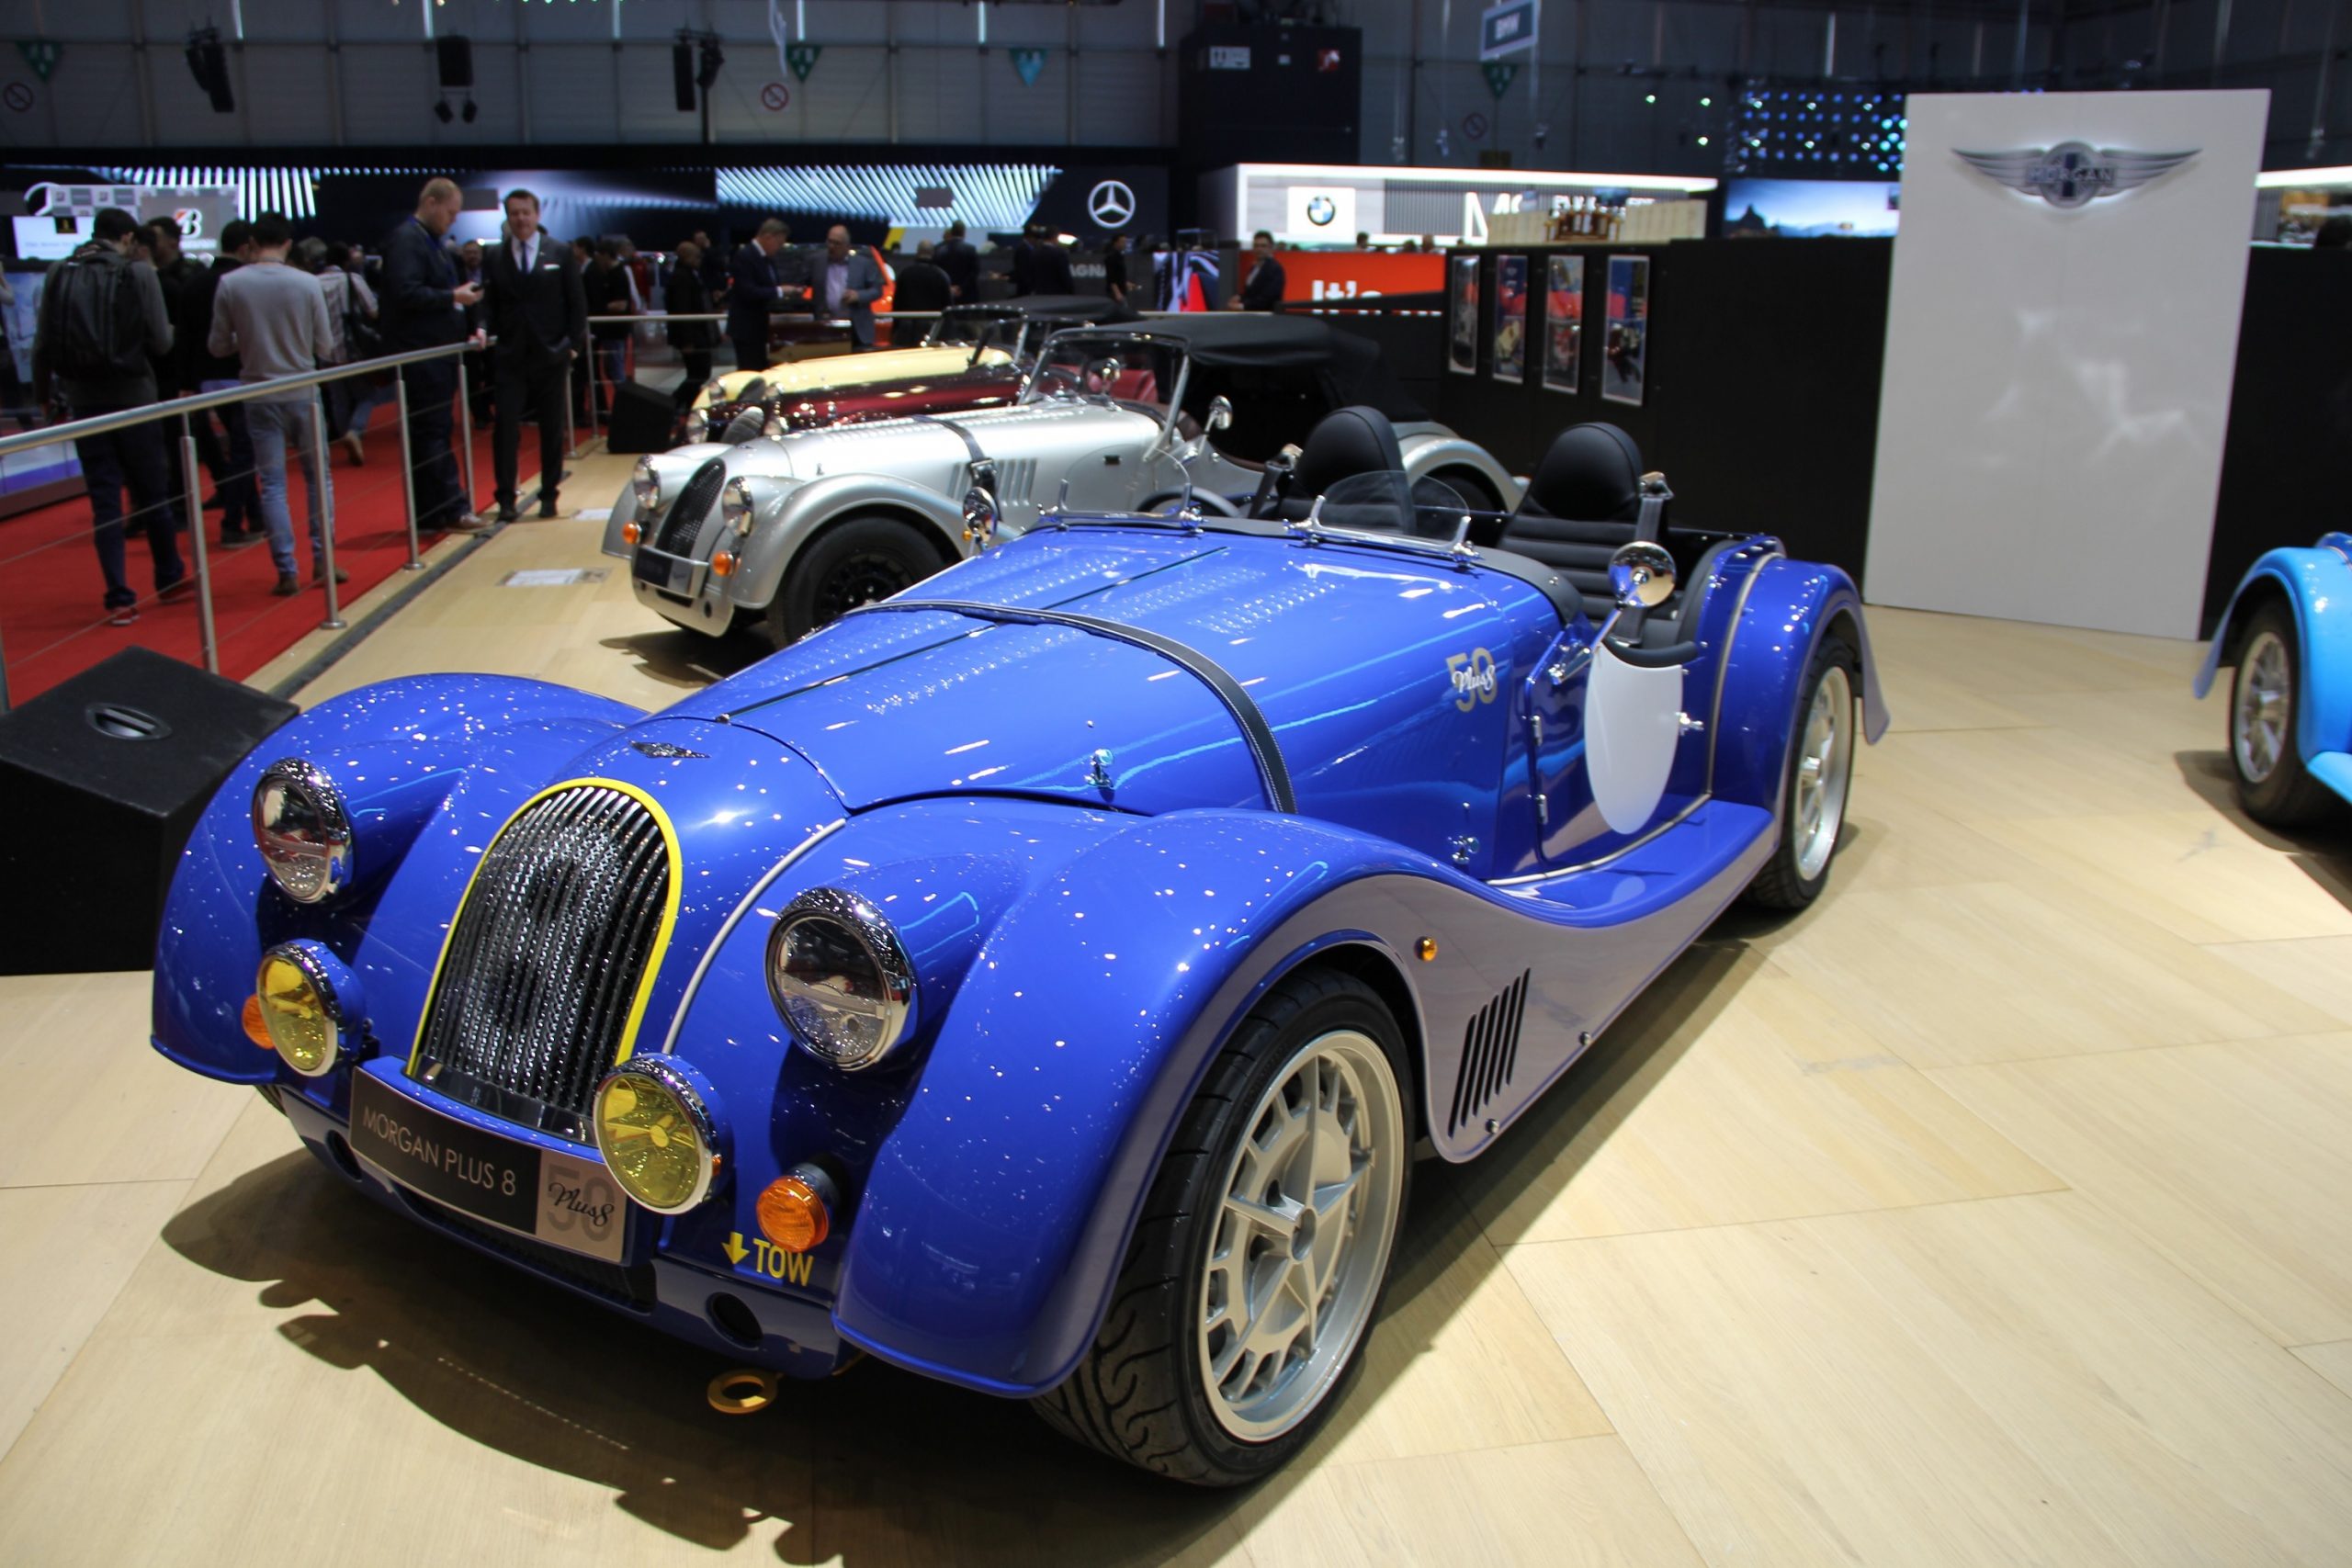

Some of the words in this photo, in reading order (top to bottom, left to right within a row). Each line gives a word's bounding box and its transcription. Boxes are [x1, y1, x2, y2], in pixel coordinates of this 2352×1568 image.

[362, 1106, 439, 1168] MORGAN
[445, 1148, 496, 1190] PLUS
[502, 1169, 516, 1196] 8
[752, 1237, 814, 1287] TOW
